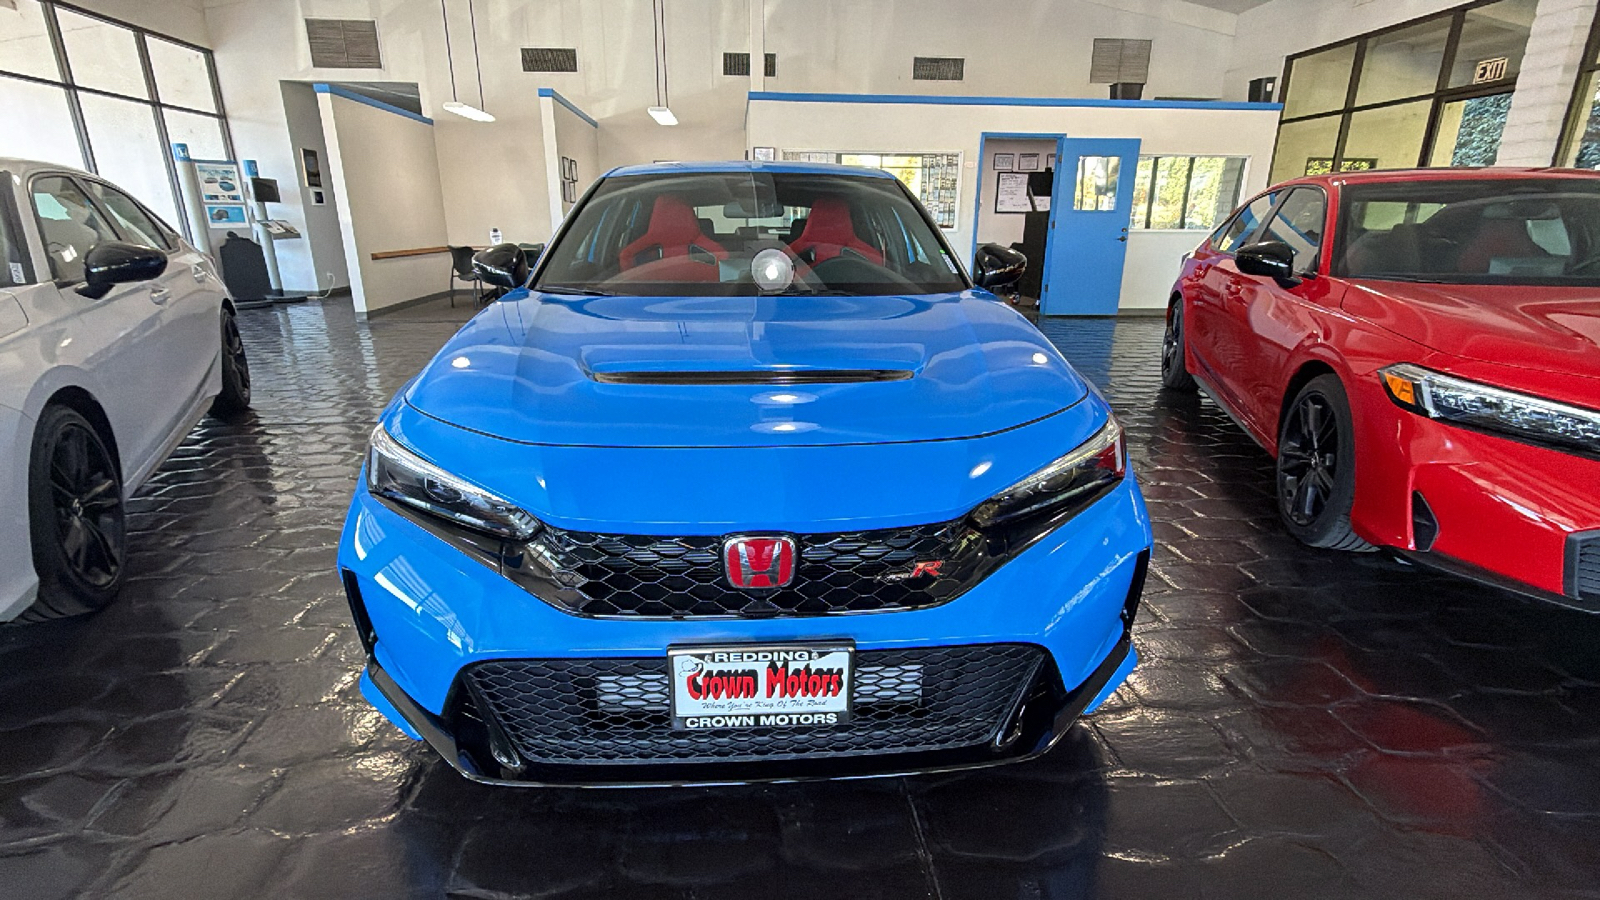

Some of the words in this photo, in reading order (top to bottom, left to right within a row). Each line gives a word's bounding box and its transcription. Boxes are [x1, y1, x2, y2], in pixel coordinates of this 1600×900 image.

[1477, 61, 1505, 80] EXIT
[714, 651, 809, 663] REDDING
[686, 668, 758, 701] Crown
[766, 663, 843, 699] Motors
[701, 701, 726, 710] Where
[727, 701, 753, 712] You're
[754, 700, 774, 709] King
[776, 699, 788, 708] Of
[789, 699, 803, 708] The
[806, 699, 828, 707] Road
[686, 716, 755, 728] CROWN
[759, 712, 838, 726] MOTORS
